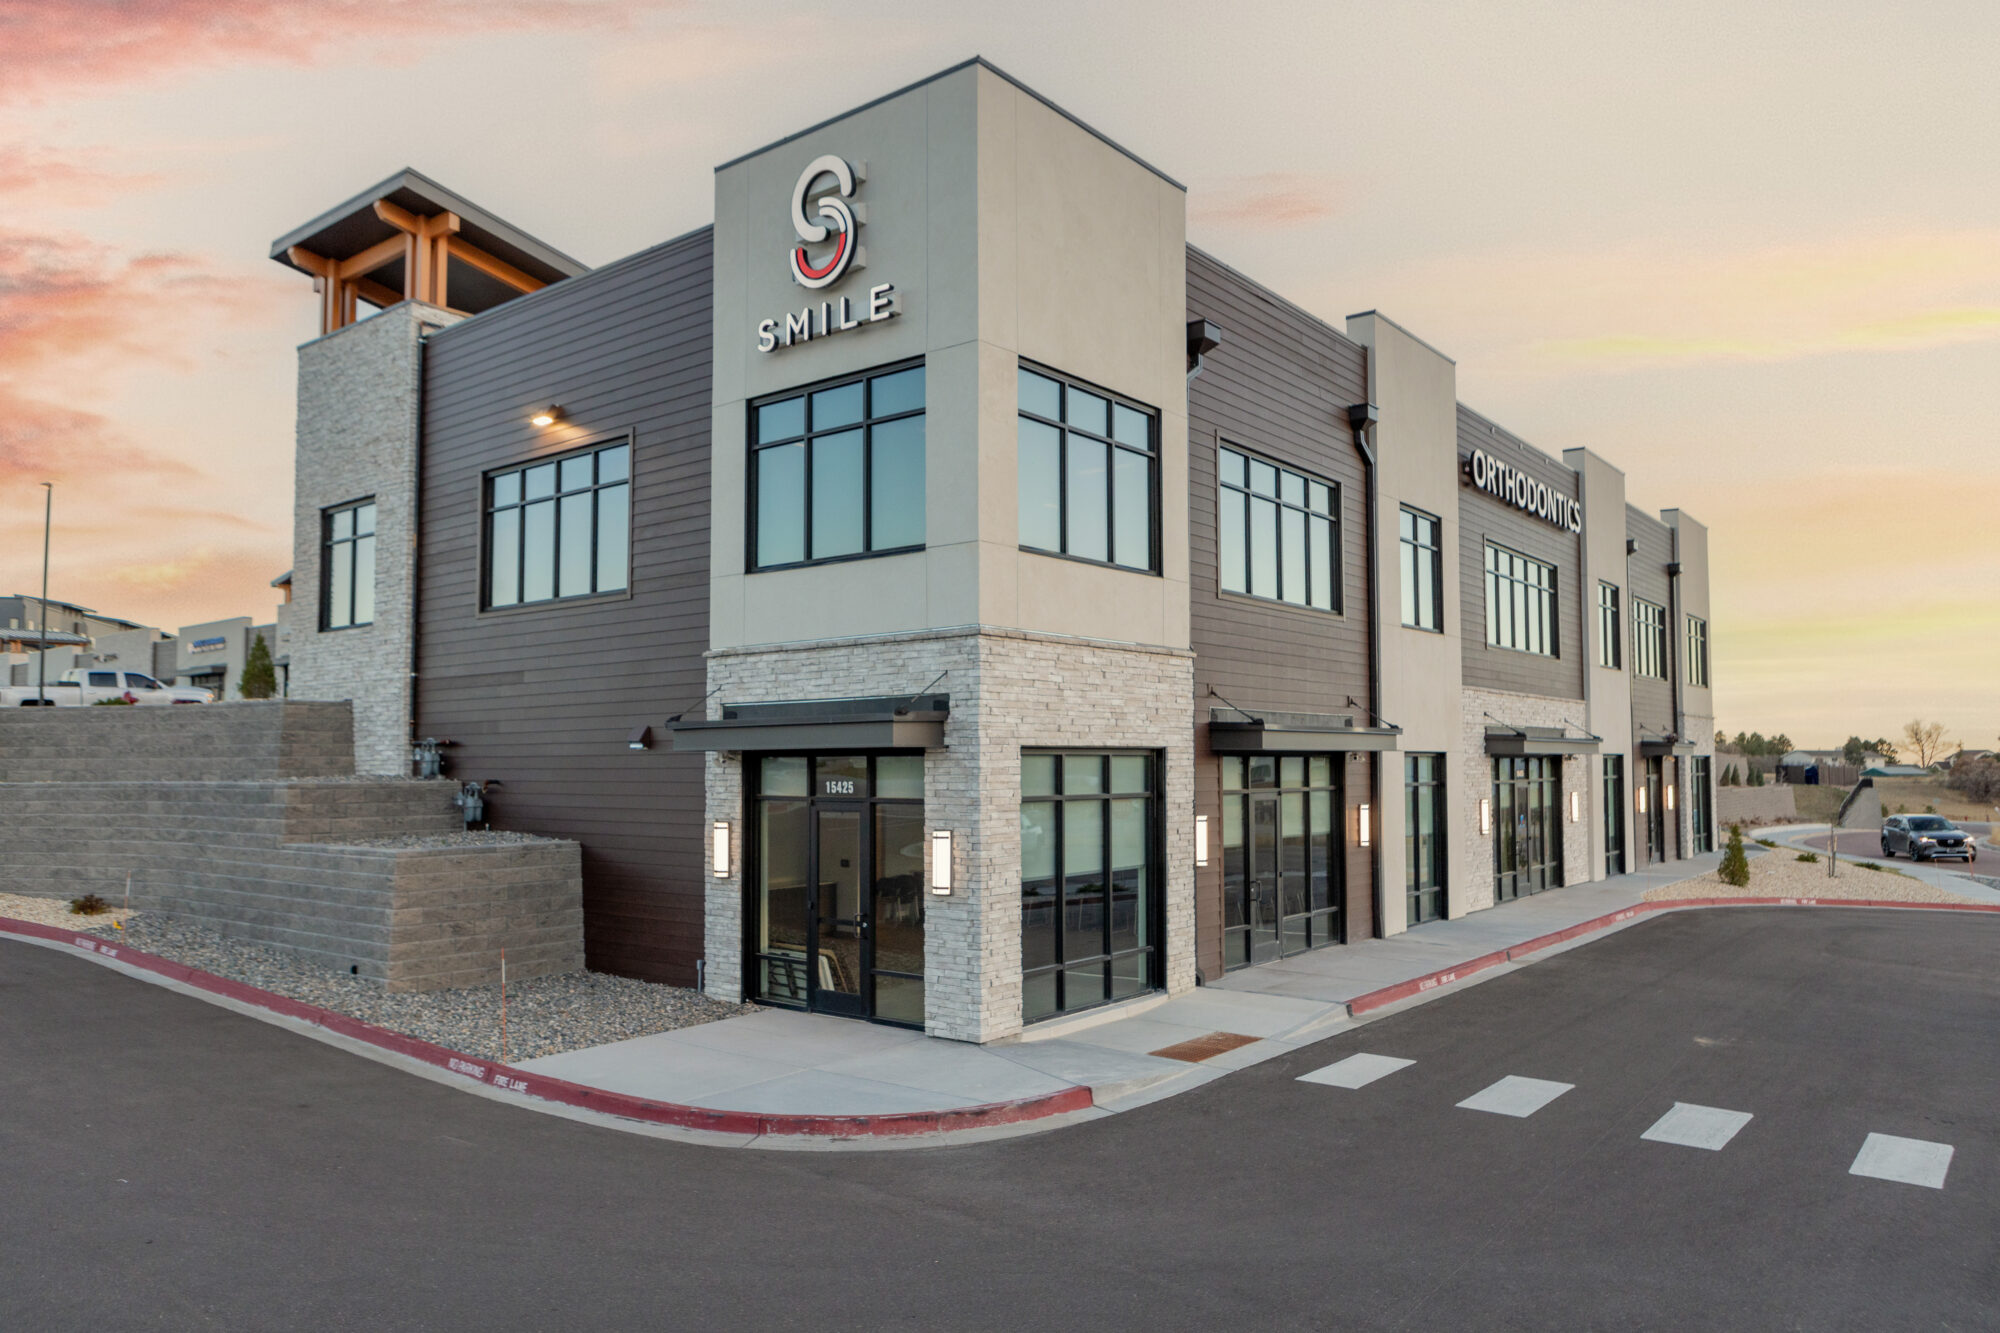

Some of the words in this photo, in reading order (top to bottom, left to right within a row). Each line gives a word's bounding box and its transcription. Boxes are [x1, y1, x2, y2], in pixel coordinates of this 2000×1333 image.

[757, 282, 894, 353] SMILE
[1472, 449, 1581, 534] ORTHODONTICS
[826, 781, 854, 794] 15425
[493, 1074, 510, 1088] FIRE
[509, 1078, 528, 1093] LANE
